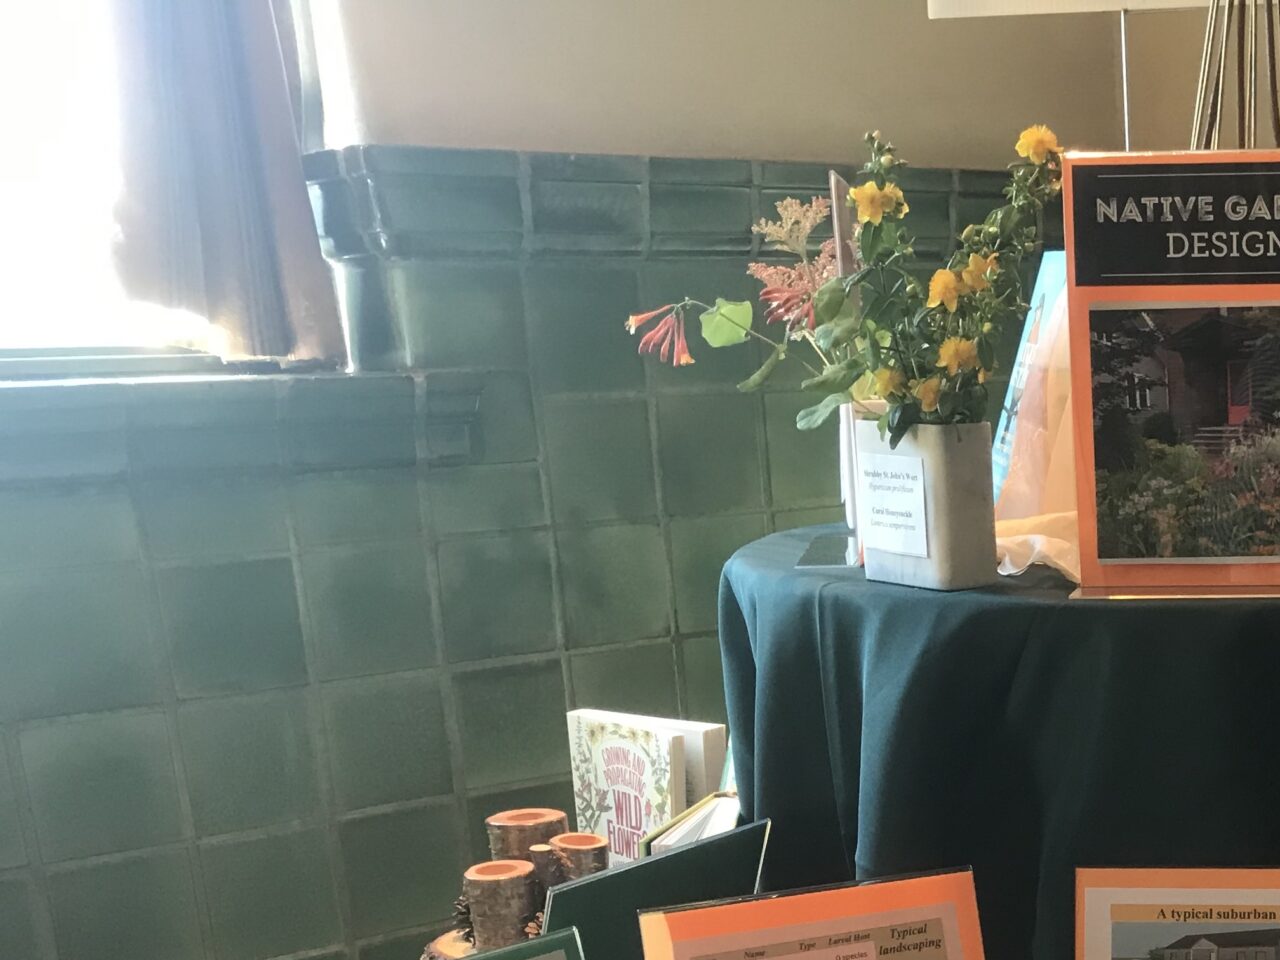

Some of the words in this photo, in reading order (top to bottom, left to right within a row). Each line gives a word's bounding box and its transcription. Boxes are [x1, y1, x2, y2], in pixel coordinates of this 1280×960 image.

[1097, 195, 1214, 223] NATIVE
[612, 788, 642, 831] WILD
[1157, 908, 1166, 919] A
[1170, 907, 1212, 921] typical
[1216, 908, 1276, 919] suburban
[889, 922, 927, 940] Typical
[878, 938, 941, 955] landscaping
